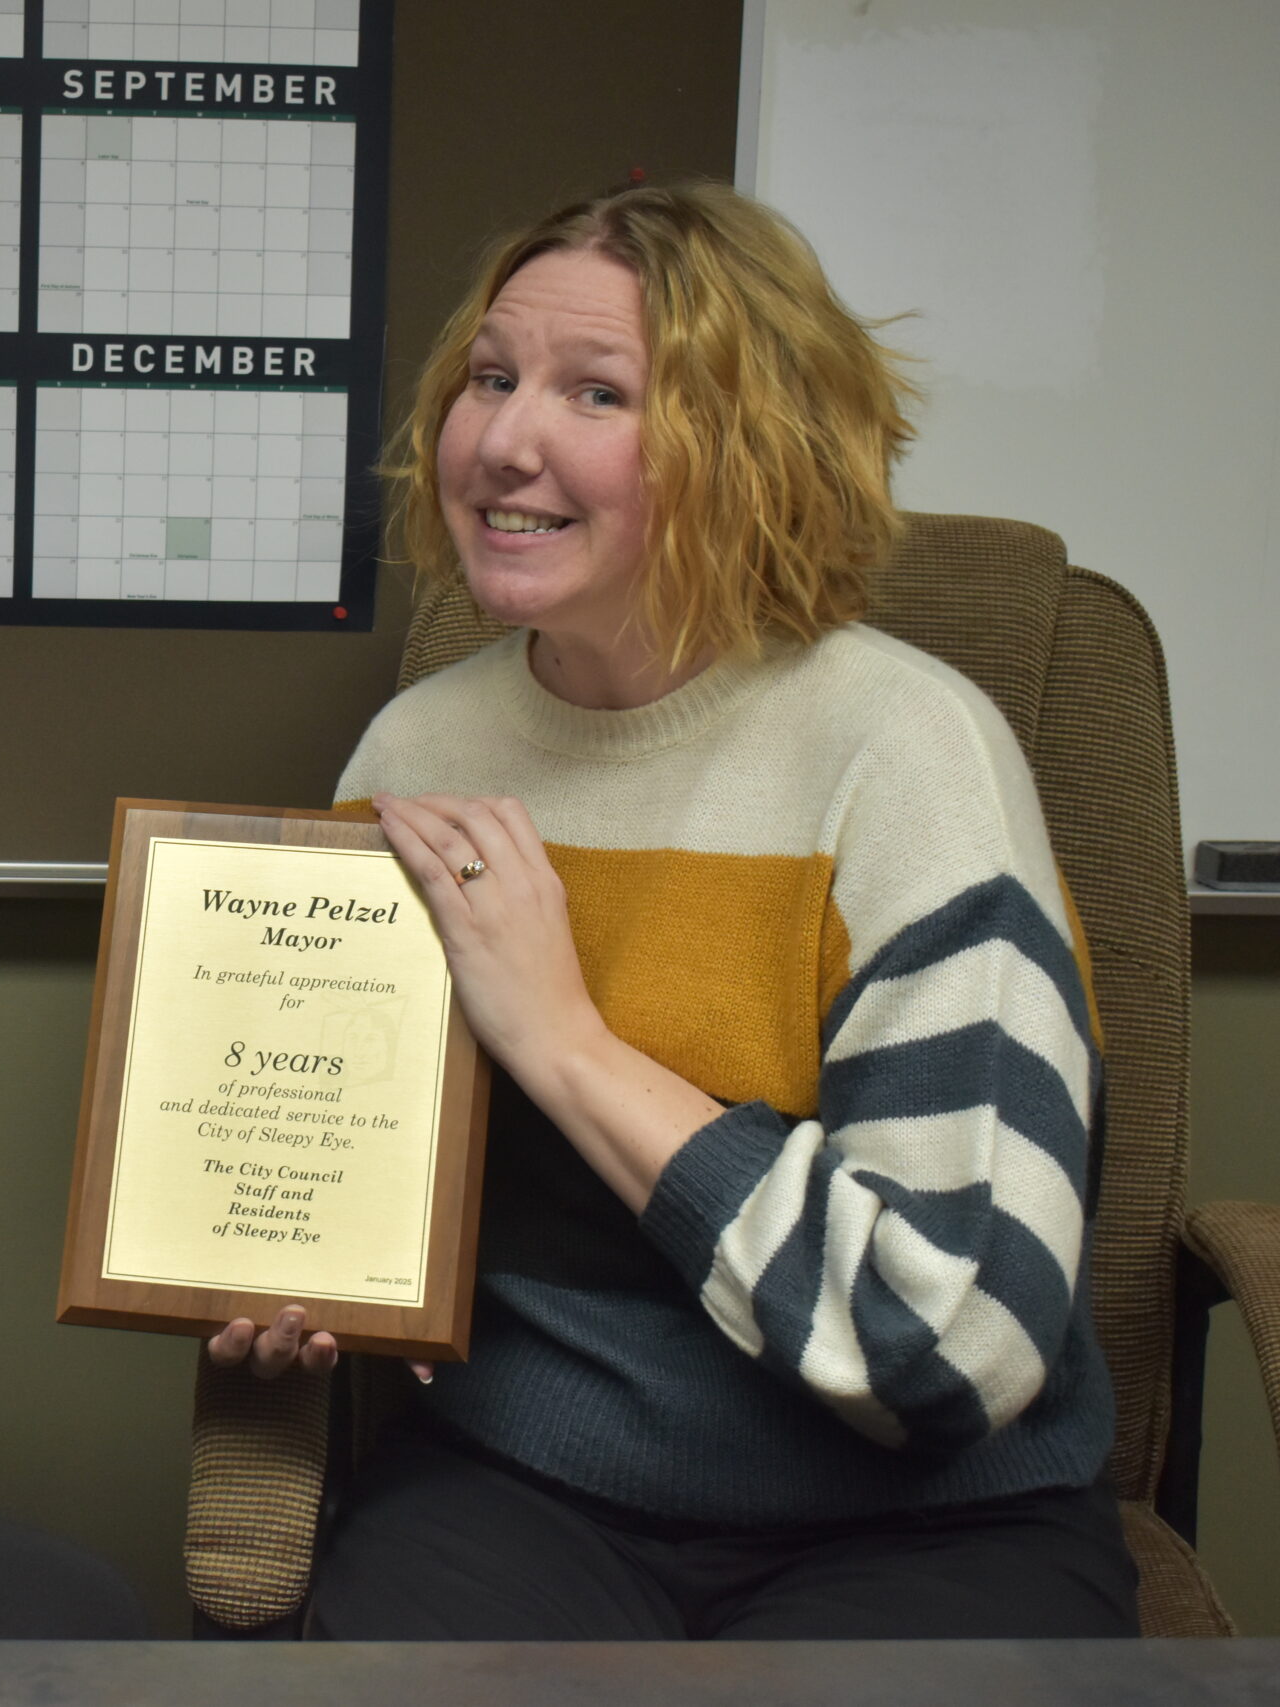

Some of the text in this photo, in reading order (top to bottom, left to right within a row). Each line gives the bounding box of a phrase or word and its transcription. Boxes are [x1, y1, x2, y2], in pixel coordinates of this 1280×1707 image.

[64, 70, 335, 105] SEPTEMBER
[73, 344, 315, 376] DECEMBER
[202, 888, 400, 925] Wayne Pelzel
[259, 926, 343, 953] Mayor
[192, 964, 396, 994] In grateful appreciation
[279, 993, 305, 1011] for
[224, 1040, 344, 1077] 8 years
[218, 1079, 343, 1103] of professional
[159, 1097, 399, 1130] and dedicated service to the
[197, 1121, 355, 1151] City of Sleepy Eye.
[203, 1158, 344, 1184] The City Council
[233, 1181, 315, 1202] Staff and
[227, 1201, 311, 1222] Residents
[211, 1221, 321, 1245] of Sleepy Eye
[365, 1275, 393, 1286] January
